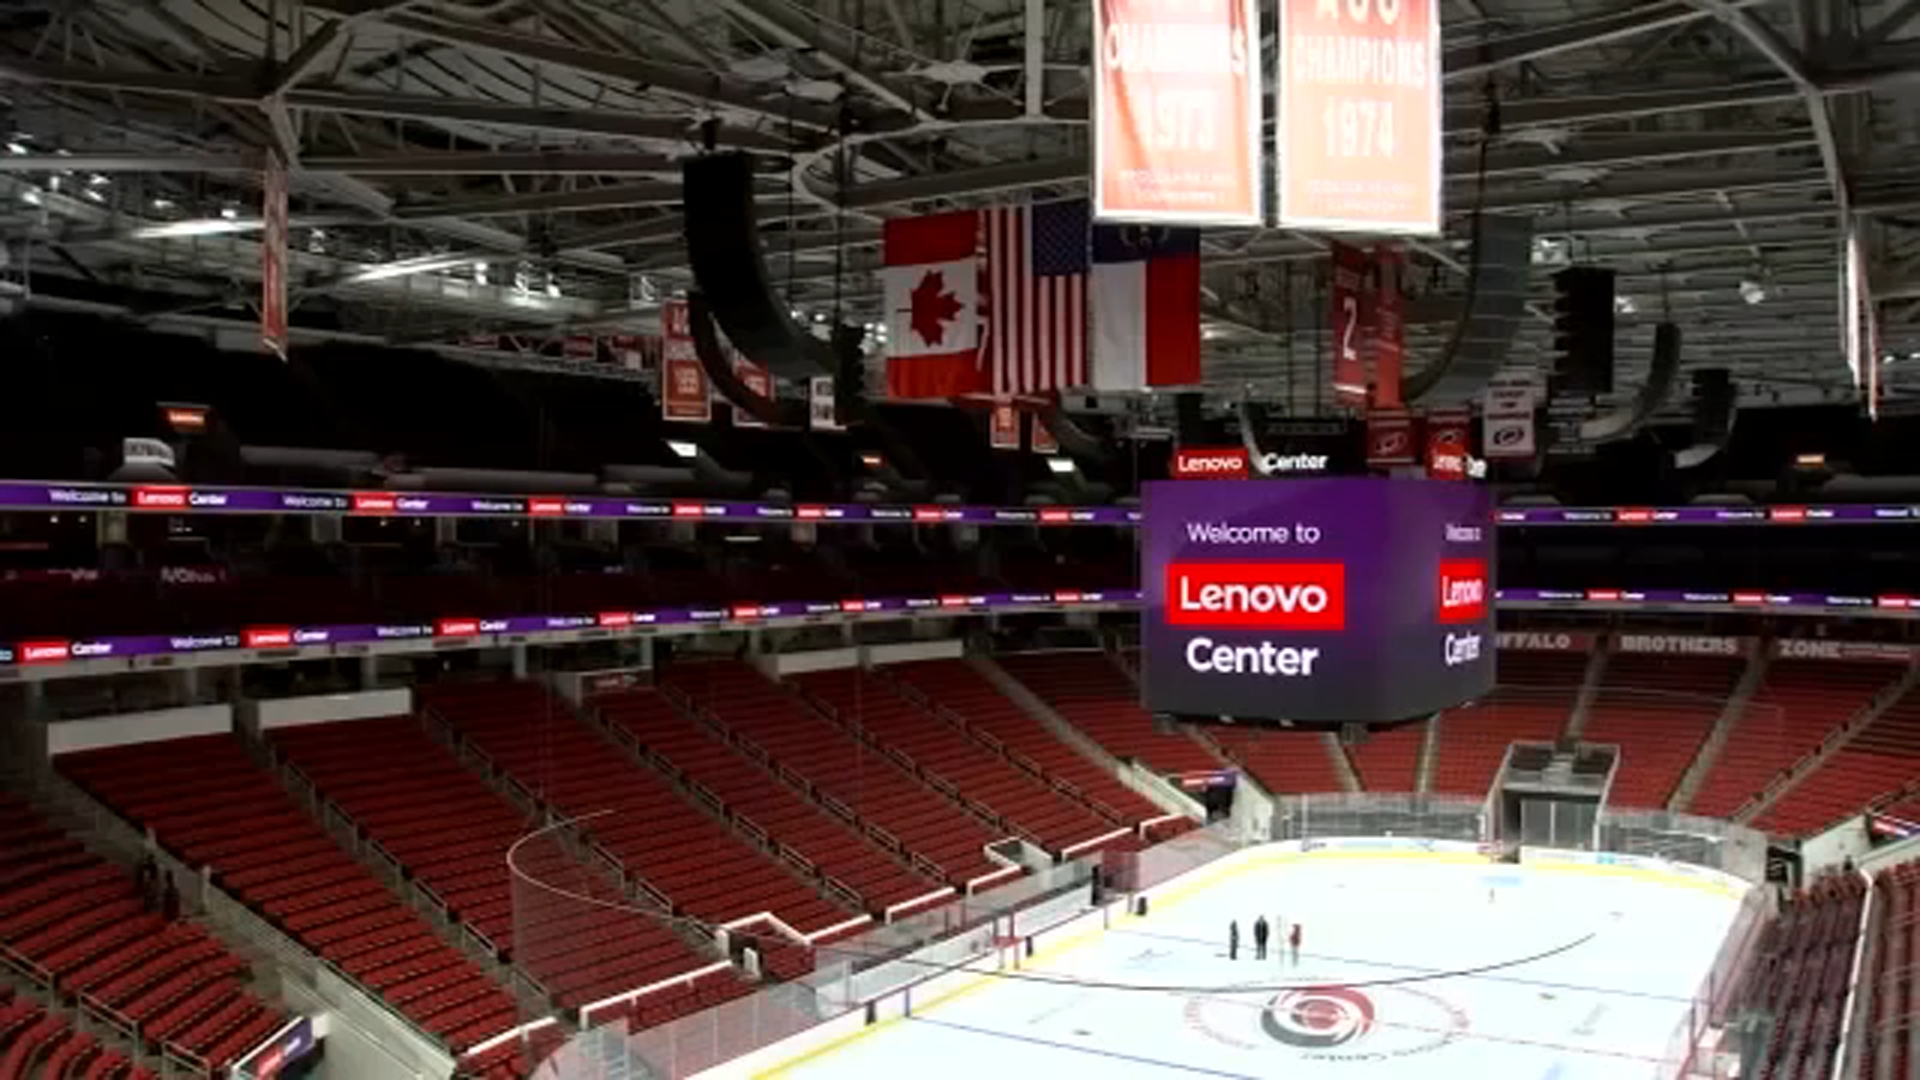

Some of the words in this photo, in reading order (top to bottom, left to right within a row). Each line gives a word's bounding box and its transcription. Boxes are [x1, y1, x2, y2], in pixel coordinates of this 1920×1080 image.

[1293, 36, 1424, 88] CHAMPIONS
[1323, 98, 1397, 157] 1974
[1178, 454, 1243, 472] Lenovo
[1260, 453, 1328, 471] Center
[1187, 523, 1289, 543] Welcome
[1296, 523, 1320, 543] to
[1180, 576, 1328, 613] Lenovo
[1442, 576, 1483, 607] Lenovo
[1186, 637, 1320, 676] Center
[1445, 631, 1481, 666] Center
[1621, 635, 1737, 654] BROTHERS
[1779, 640, 1840, 658] ZONE
